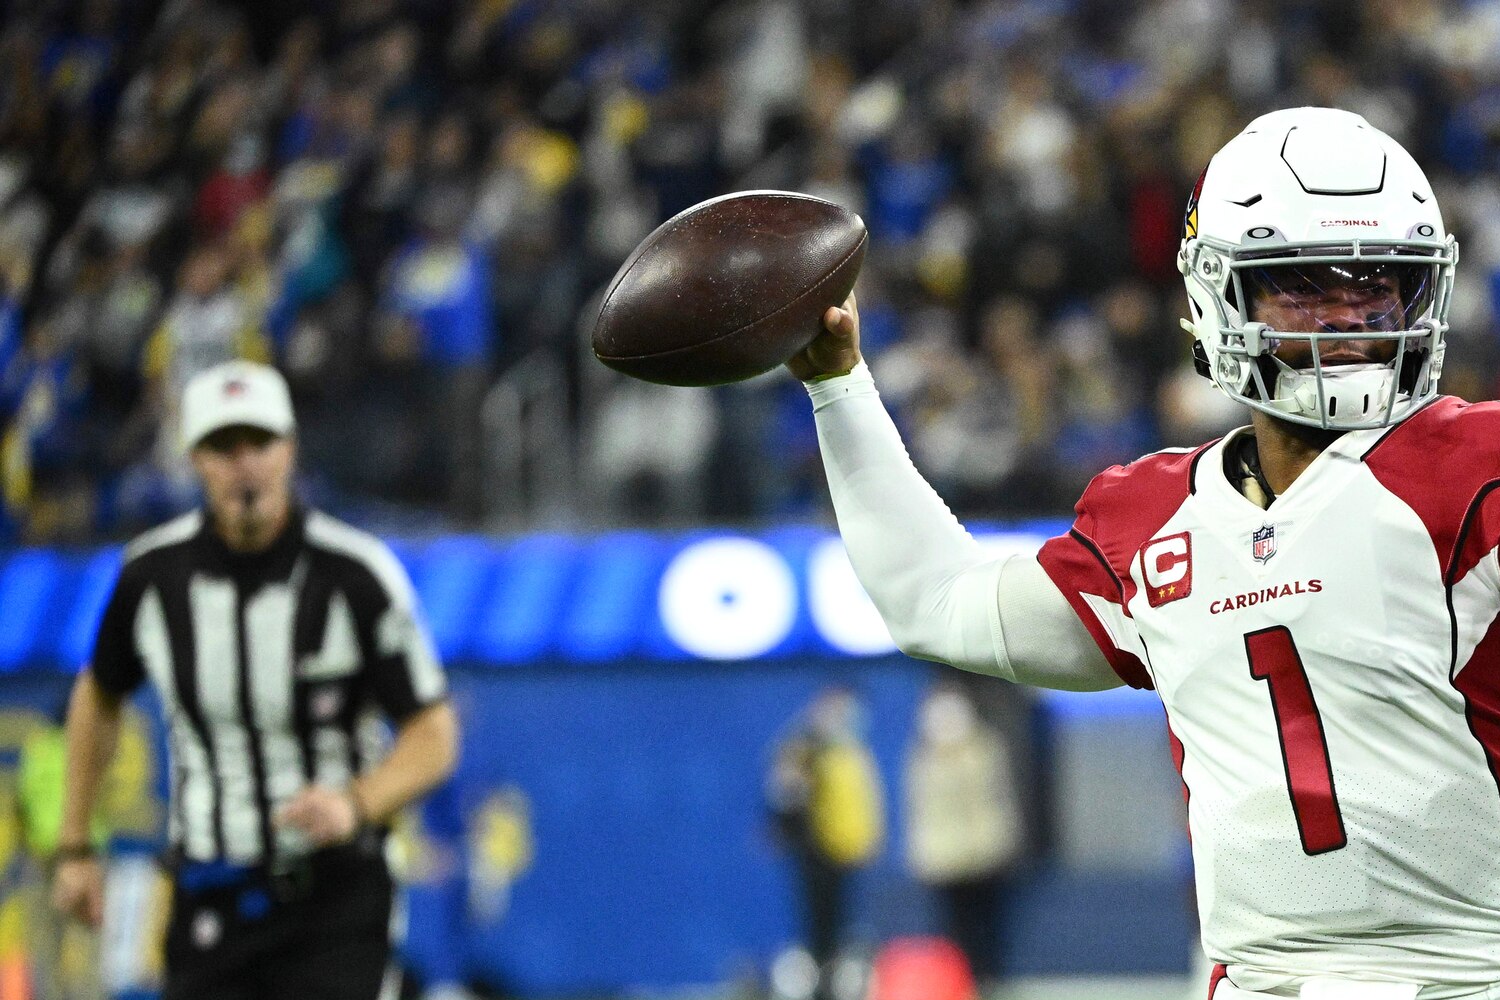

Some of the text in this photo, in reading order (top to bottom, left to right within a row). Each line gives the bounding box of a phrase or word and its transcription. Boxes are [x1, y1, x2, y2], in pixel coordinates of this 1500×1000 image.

[1143, 537, 1188, 588] C
[1255, 539, 1273, 556] NFL
[1209, 578, 1323, 615] CARDINALS
[1243, 624, 1348, 856] 1
